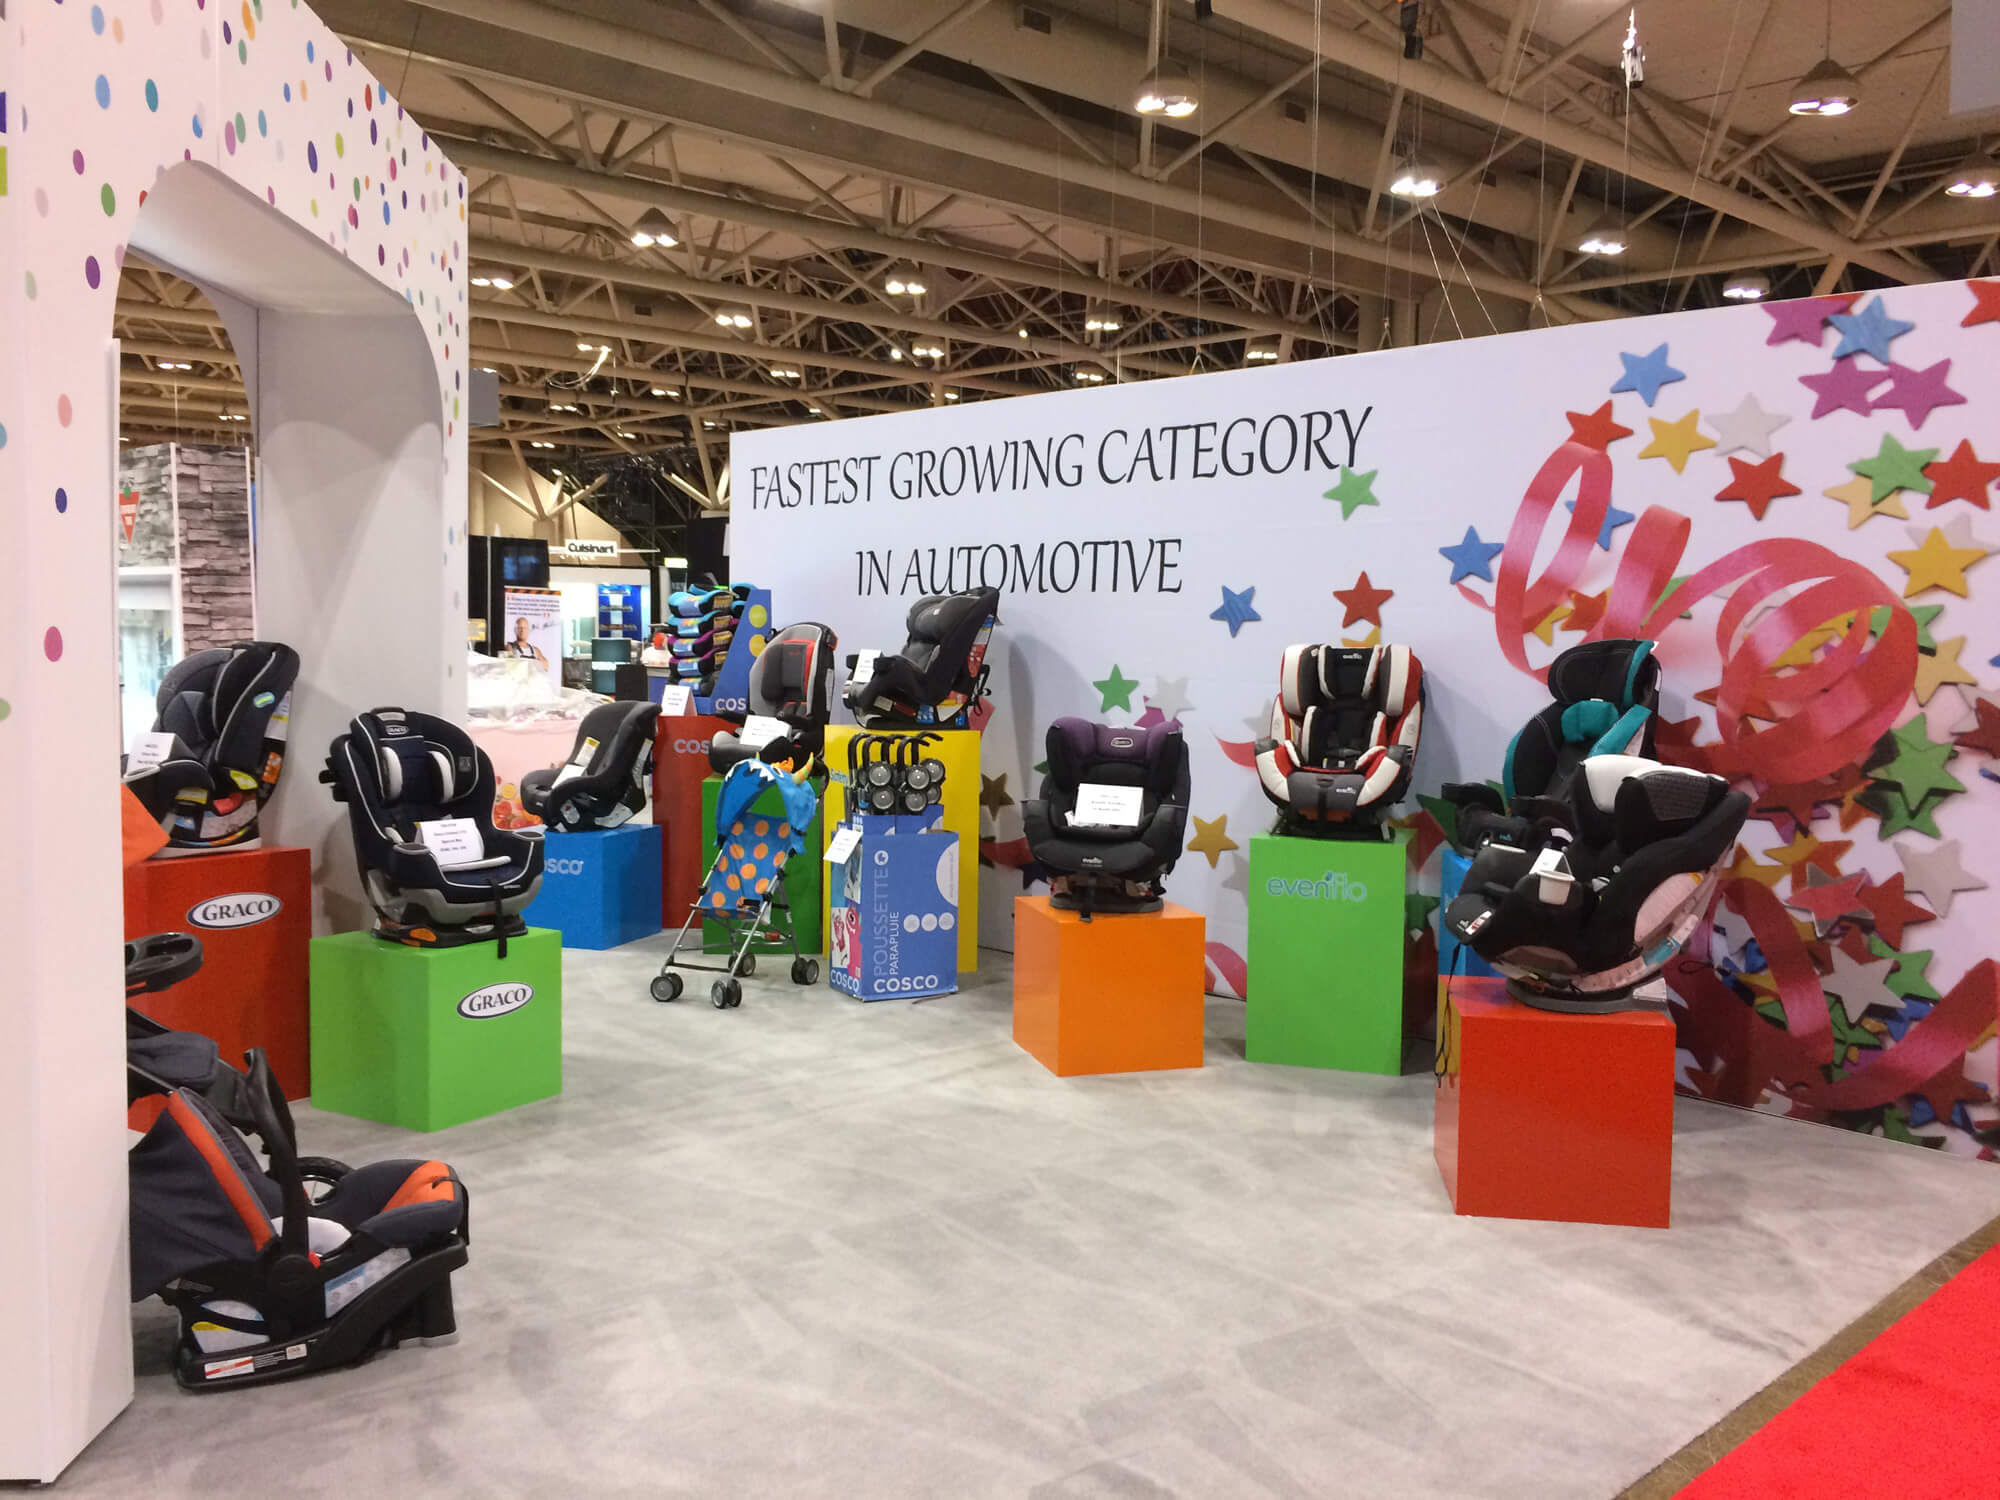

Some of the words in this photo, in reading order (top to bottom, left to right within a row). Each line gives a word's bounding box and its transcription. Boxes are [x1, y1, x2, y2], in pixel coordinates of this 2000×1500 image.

[750, 456, 881, 510] FASTEST
[888, 433, 1084, 500] GROWING
[1098, 406, 1373, 485] CATEGORY
[568, 542, 615, 554] Cuisinart
[856, 550, 891, 596] IN
[900, 538, 1183, 596] AUTOMOTIVE
[715, 697, 747, 711] COS
[673, 739, 710, 754] COS
[1266, 871, 1367, 901] evenflo
[202, 898, 274, 921] GRACO
[873, 868, 889, 976] POUSSETTE
[889, 911, 900, 975] PARAPLUIE
[468, 987, 527, 1013] GRACO
